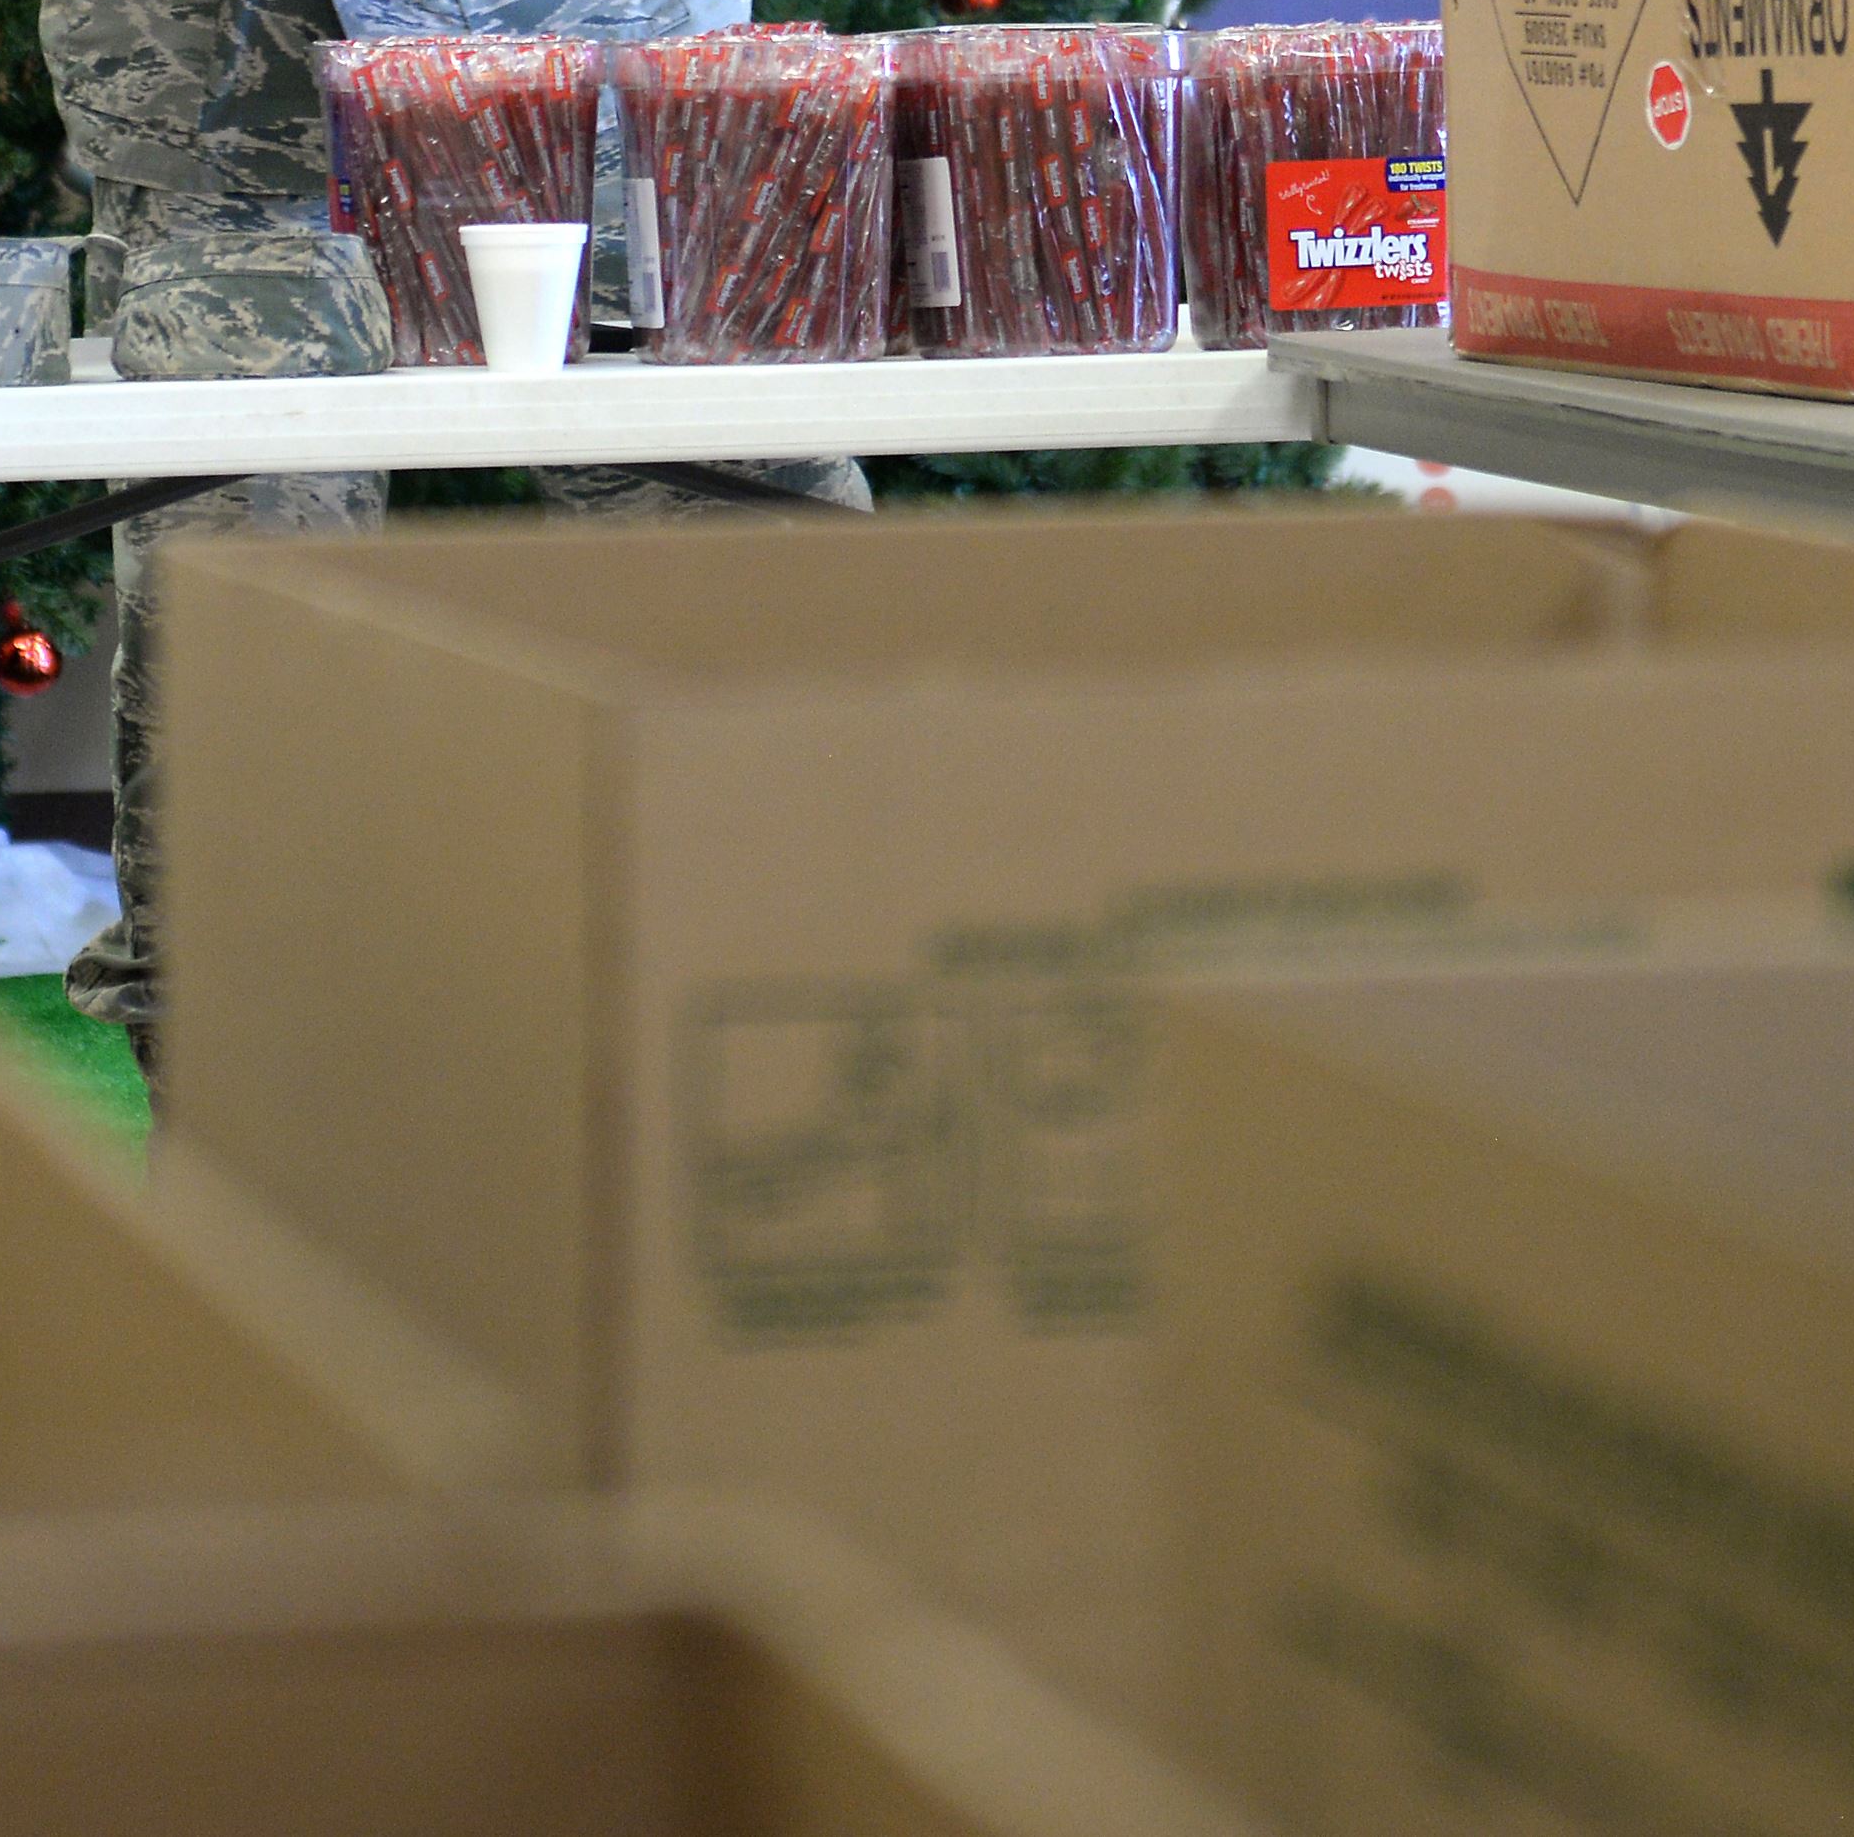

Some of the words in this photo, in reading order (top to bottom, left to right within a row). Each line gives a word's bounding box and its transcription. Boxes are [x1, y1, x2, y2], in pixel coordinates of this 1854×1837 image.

[1572, 22, 1607, 49] SKU#
[1578, 62, 1606, 88] PO#
[1653, 91, 1685, 118] STOP
[1408, 160, 1443, 174] TWISTS
[1289, 226, 1427, 269] Twizzlers
[1373, 259, 1434, 282] twists
[1545, 298, 1610, 349] THEMED
[1666, 307, 1766, 363] ORNAMENTS
[1766, 316, 1838, 370] THEMED
